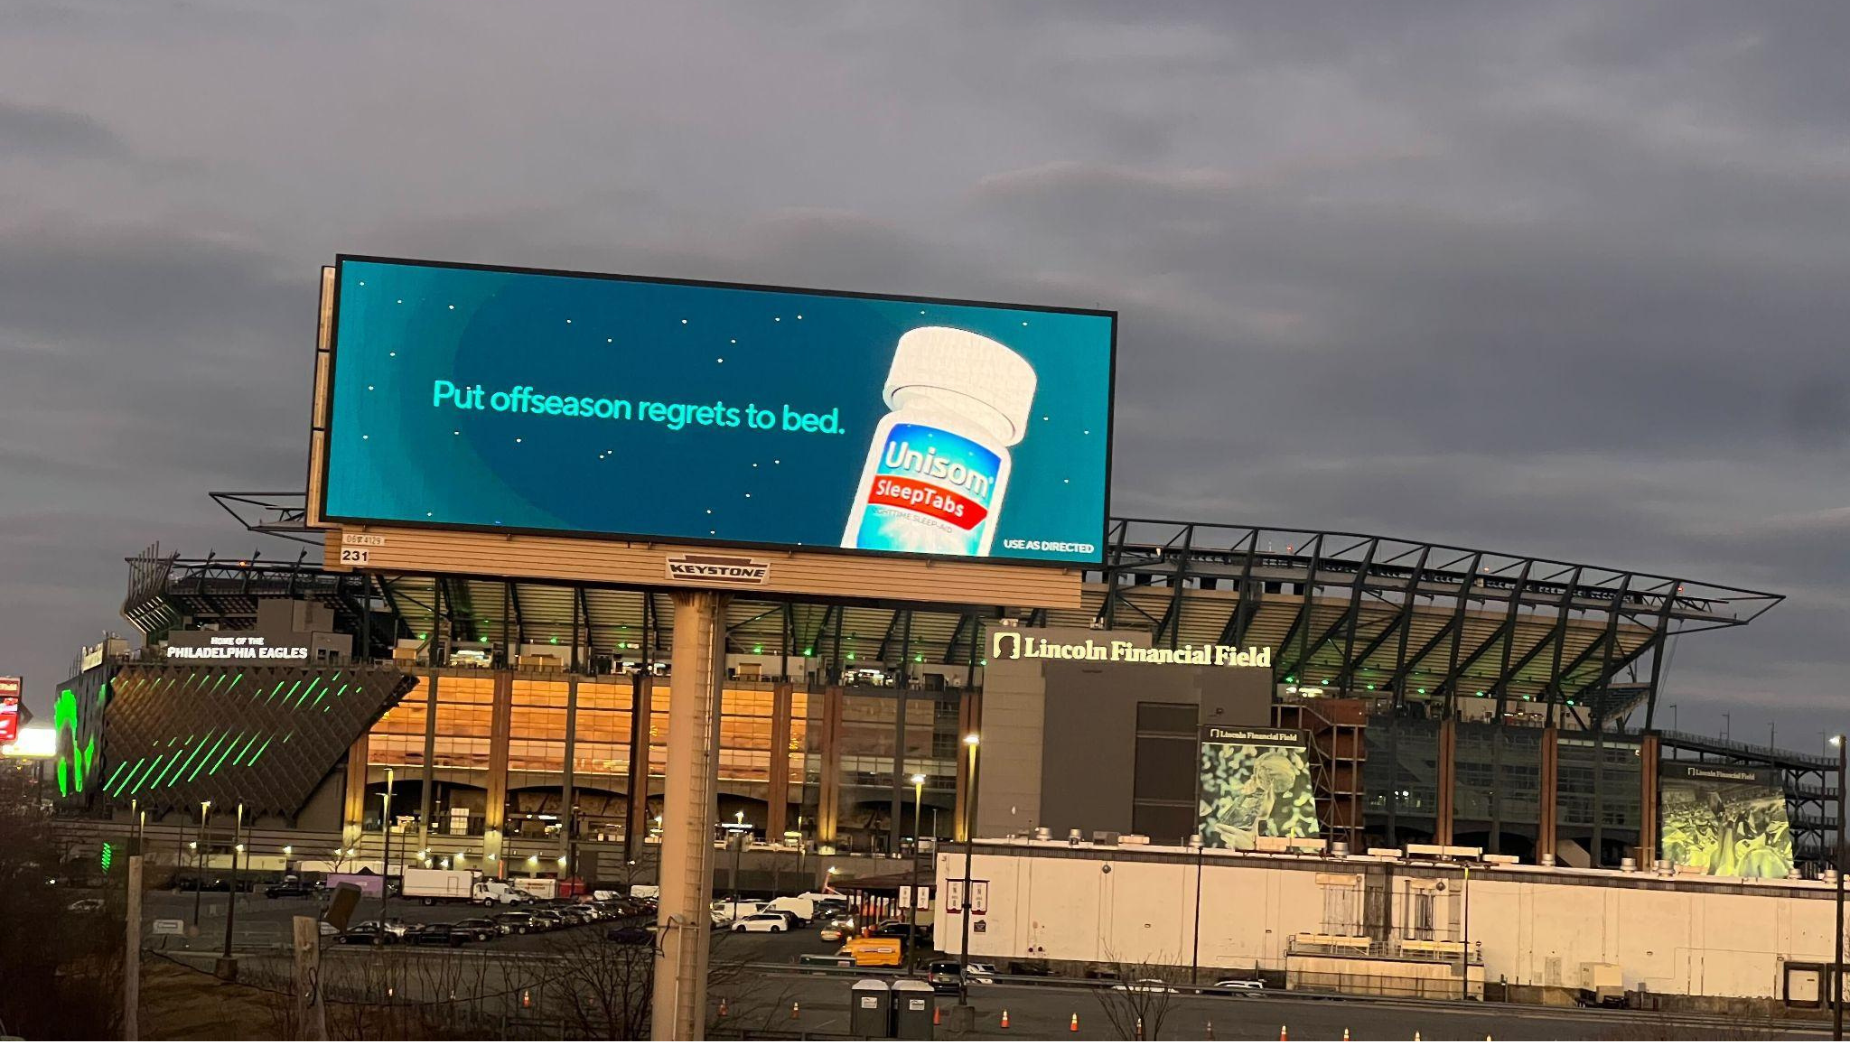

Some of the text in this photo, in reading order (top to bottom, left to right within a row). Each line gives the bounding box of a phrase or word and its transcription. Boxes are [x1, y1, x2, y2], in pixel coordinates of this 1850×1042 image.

[433, 380, 846, 435] Put offseason regrets to bed.
[885, 440, 989, 499] Unisom
[876, 479, 965, 517] SleepTabs
[1003, 539, 1095, 553] USE AS DIRECTED
[342, 550, 368, 562] 231
[669, 564, 766, 578] KEYSTONE
[210, 637, 265, 645] HOME OF THE
[167, 646, 308, 659] PHILADELPHIA EAGLES
[1024, 637, 1271, 667] Lincoln Financial Field
